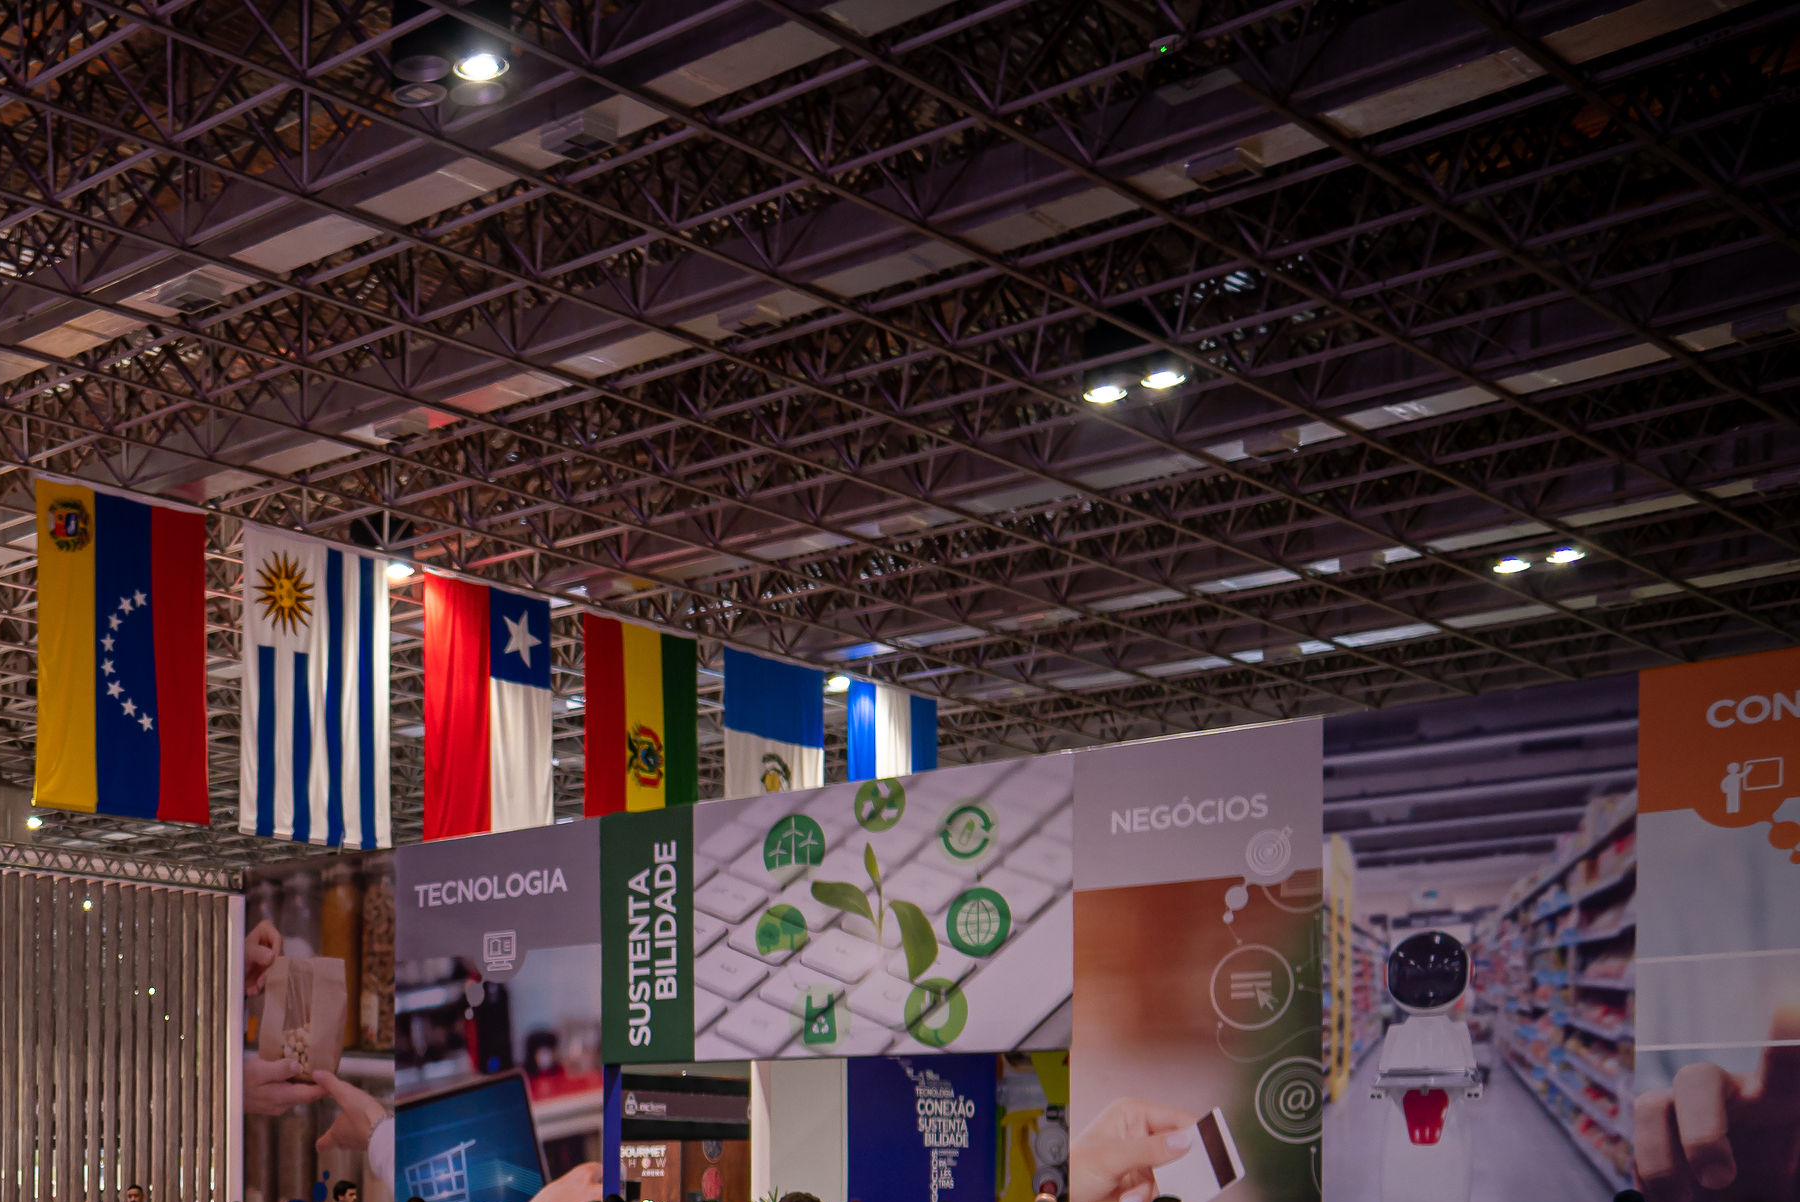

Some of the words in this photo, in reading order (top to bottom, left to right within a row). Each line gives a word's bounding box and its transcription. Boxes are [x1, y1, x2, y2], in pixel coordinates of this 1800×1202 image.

[1111, 792, 1269, 836] NEGÓCIOS
[414, 867, 568, 908] TECNOLOGIA
[654, 838, 678, 1001] BILIDADE
[628, 867, 652, 1047] SUSTENTA
[916, 1094, 975, 1119] CONEXÃO
[917, 1116, 968, 1133] SUSTENTA
[923, 1131, 970, 1148] BILIDADE
